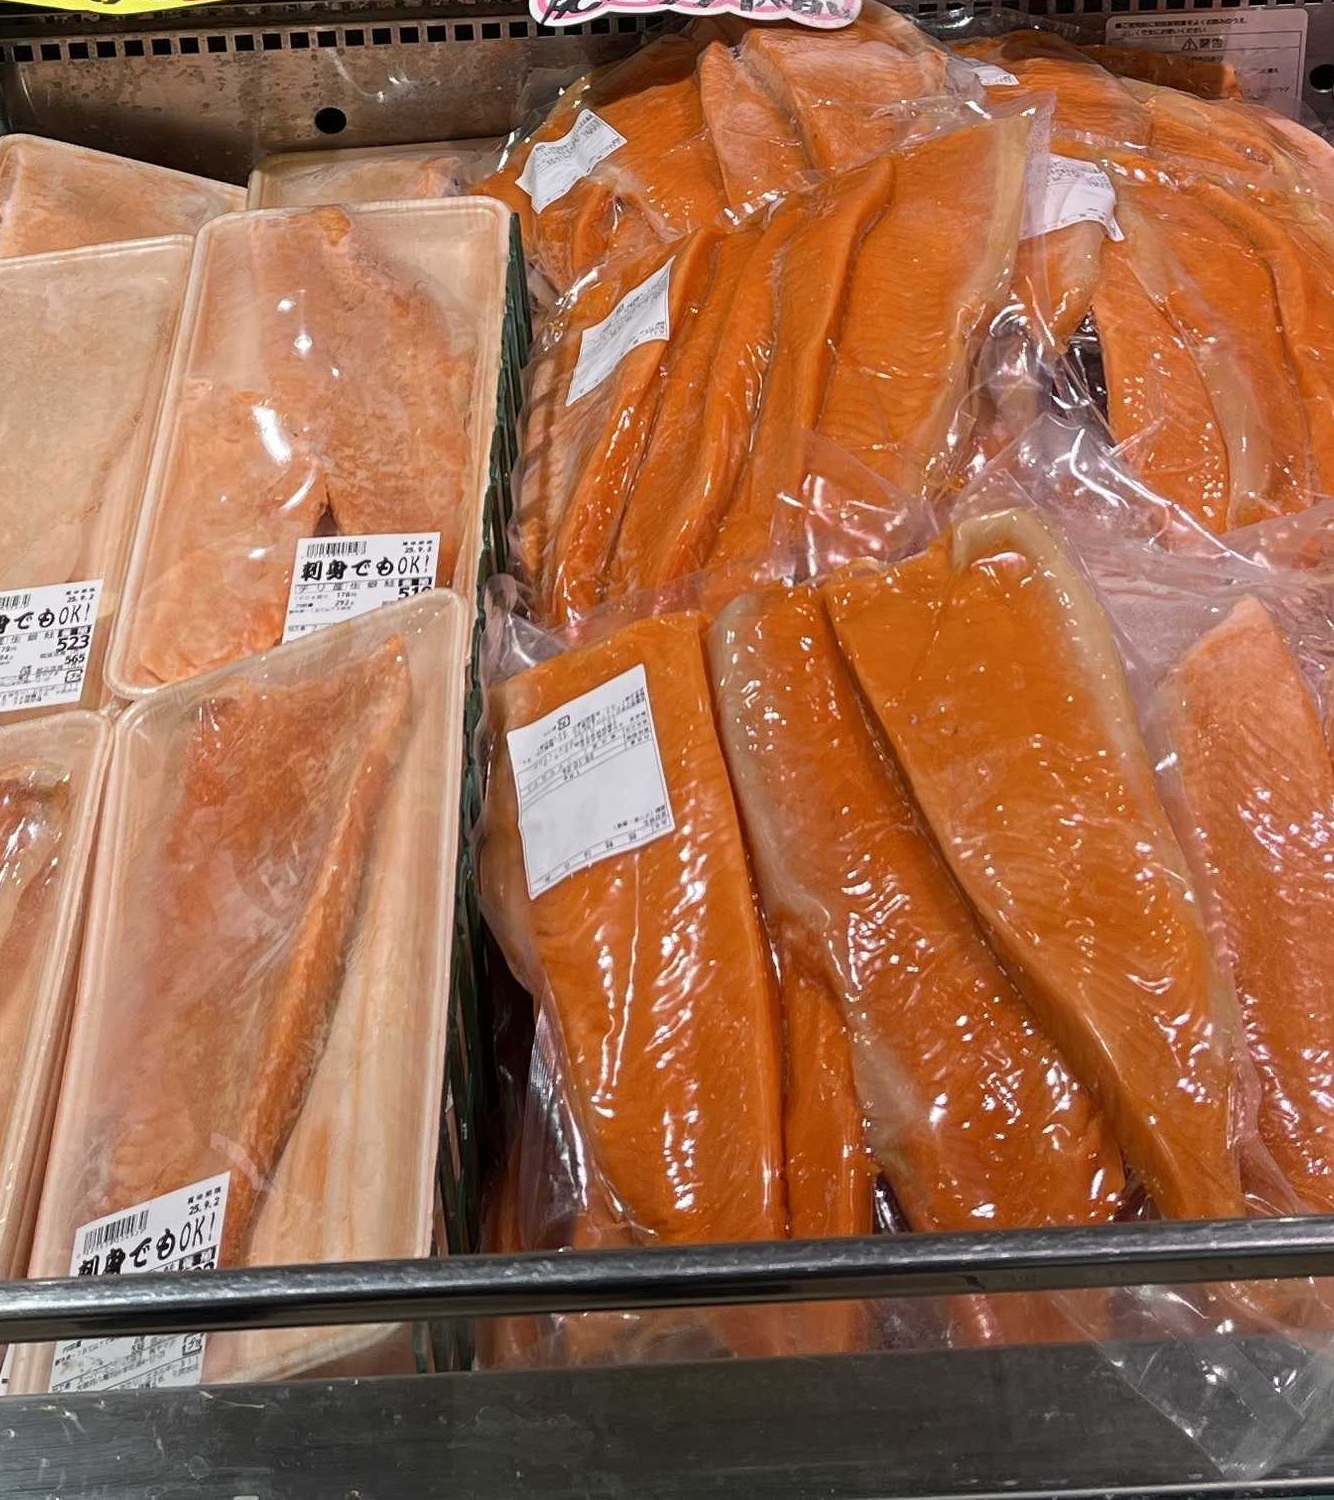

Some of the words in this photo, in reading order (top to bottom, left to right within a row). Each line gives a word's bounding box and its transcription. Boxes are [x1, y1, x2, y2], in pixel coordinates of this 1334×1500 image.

[300, 555, 430, 582] 刺身でもOK!
[55, 634, 90, 652] 523
[188, 1196, 221, 1216] 25.9.2
